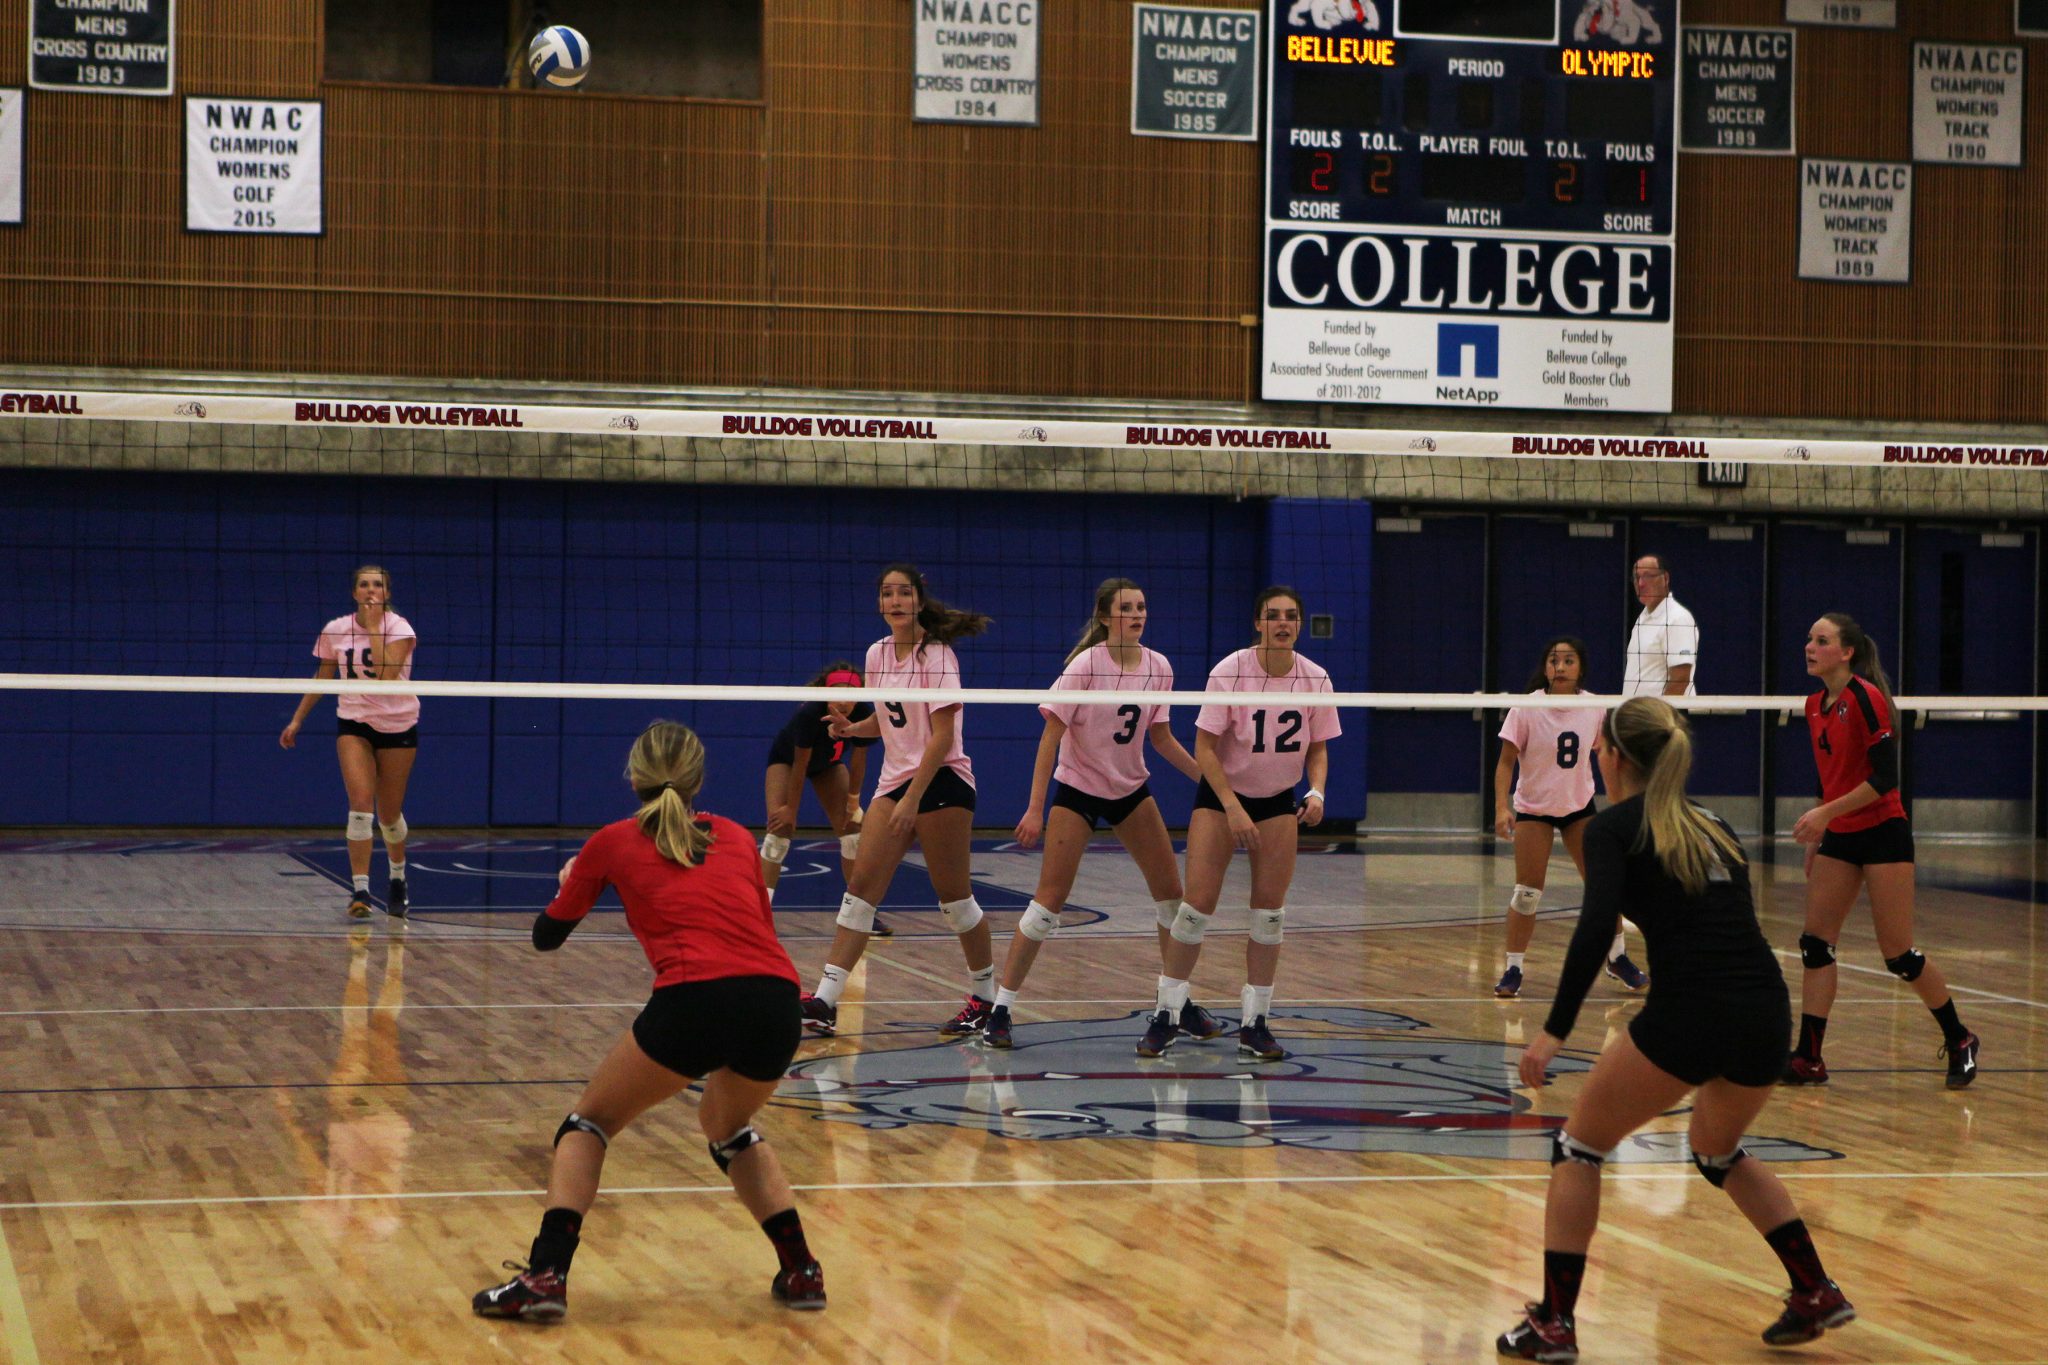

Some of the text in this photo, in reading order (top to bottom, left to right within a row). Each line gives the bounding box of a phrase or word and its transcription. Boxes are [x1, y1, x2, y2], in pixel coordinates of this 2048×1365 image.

[921, 0, 1032, 26] NWAACC
[75, 15, 128, 36] MENS
[1143, 15, 1251, 41] NWAACC
[935, 29, 1017, 49] CHAMPION
[1687, 32, 1788, 59] NWAACC
[32, 37, 168, 63] CROSS COUNTRY
[1156, 43, 1237, 63] CHAMPION
[1287, 35, 1396, 66] BELLEVUE
[942, 53, 1011, 71] WOMENS
[1448, 58, 1505, 78] PERIOD
[1562, 48, 1654, 79] OLYMPIC
[1919, 47, 2018, 75] NWAACC
[77, 64, 125, 85] 1983
[1173, 68, 1218, 86] MENS
[1699, 62, 1776, 81] CHAMPION
[915, 74, 1037, 96] CROSS COUNTRY
[1715, 85, 1757, 102] MENS
[1930, 77, 2005, 96] CHAMPION
[954, 100, 997, 117] 1984
[1163, 90, 1228, 109] SOCCER
[1936, 100, 1998, 118] WOMENS
[206, 104, 303, 132] NWAC
[1173, 114, 1216, 132] 1985
[1707, 107, 1766, 126] SOCCER
[1290, 128, 1341, 149] FOULS
[1945, 121, 1990, 139] TRACK
[210, 136, 299, 156] CHAMPION
[1360, 132, 1402, 152] T.O.L.
[1420, 135, 1528, 157] PLAYER FOUL
[1545, 140, 1586, 159] T.O.L.
[1605, 143, 1655, 162] FOULS
[217, 160, 291, 180] WOMENS
[1311, 152, 1332, 191] 2
[1370, 155, 1392, 193] 2
[1806, 164, 1907, 191] NWAACC
[1554, 162, 1576, 201] 2
[233, 186, 275, 203] GOLF
[1818, 193, 1894, 212] CHAMPION
[233, 210, 276, 228] 2015
[1289, 201, 1341, 220] SCORE
[1446, 207, 1502, 227] MATCH
[1603, 213, 1653, 232] SCORE
[1824, 215, 1888, 234] WOMENS
[1833, 238, 1878, 256] TRACK
[1277, 234, 1655, 316] COLLEGE
[1835, 260, 1874, 277] 1989
[1323, 320, 1377, 338] Funded by
[1561, 329, 1613, 347] Funded by
[1308, 341, 1391, 360] Bellevue College
[1546, 349, 1628, 367] Bellevue College
[1270, 361, 1428, 381] Associated Student Government
[1542, 370, 1631, 388] Gold Booster Club
[1316, 384, 1382, 401] of 2011-2012
[1435, 386, 1499, 404] NetApp
[1564, 392, 1609, 408] Members
[295, 402, 523, 427] BULLDOG VOLLEYBALL
[722, 415, 937, 439] BULLDOG VOLLEYBALL
[1126, 426, 1331, 449] BULLDOG VOLLEYBALL
[1512, 436, 1709, 459] BULLDOG VOLLEYBALL
[1884, 445, 1963, 464] BULLDOG
[1113, 704, 1142, 745] 3
[1252, 709, 1303, 753] 12
[1556, 731, 1580, 769] 8
[1817, 727, 1833, 756] 4
